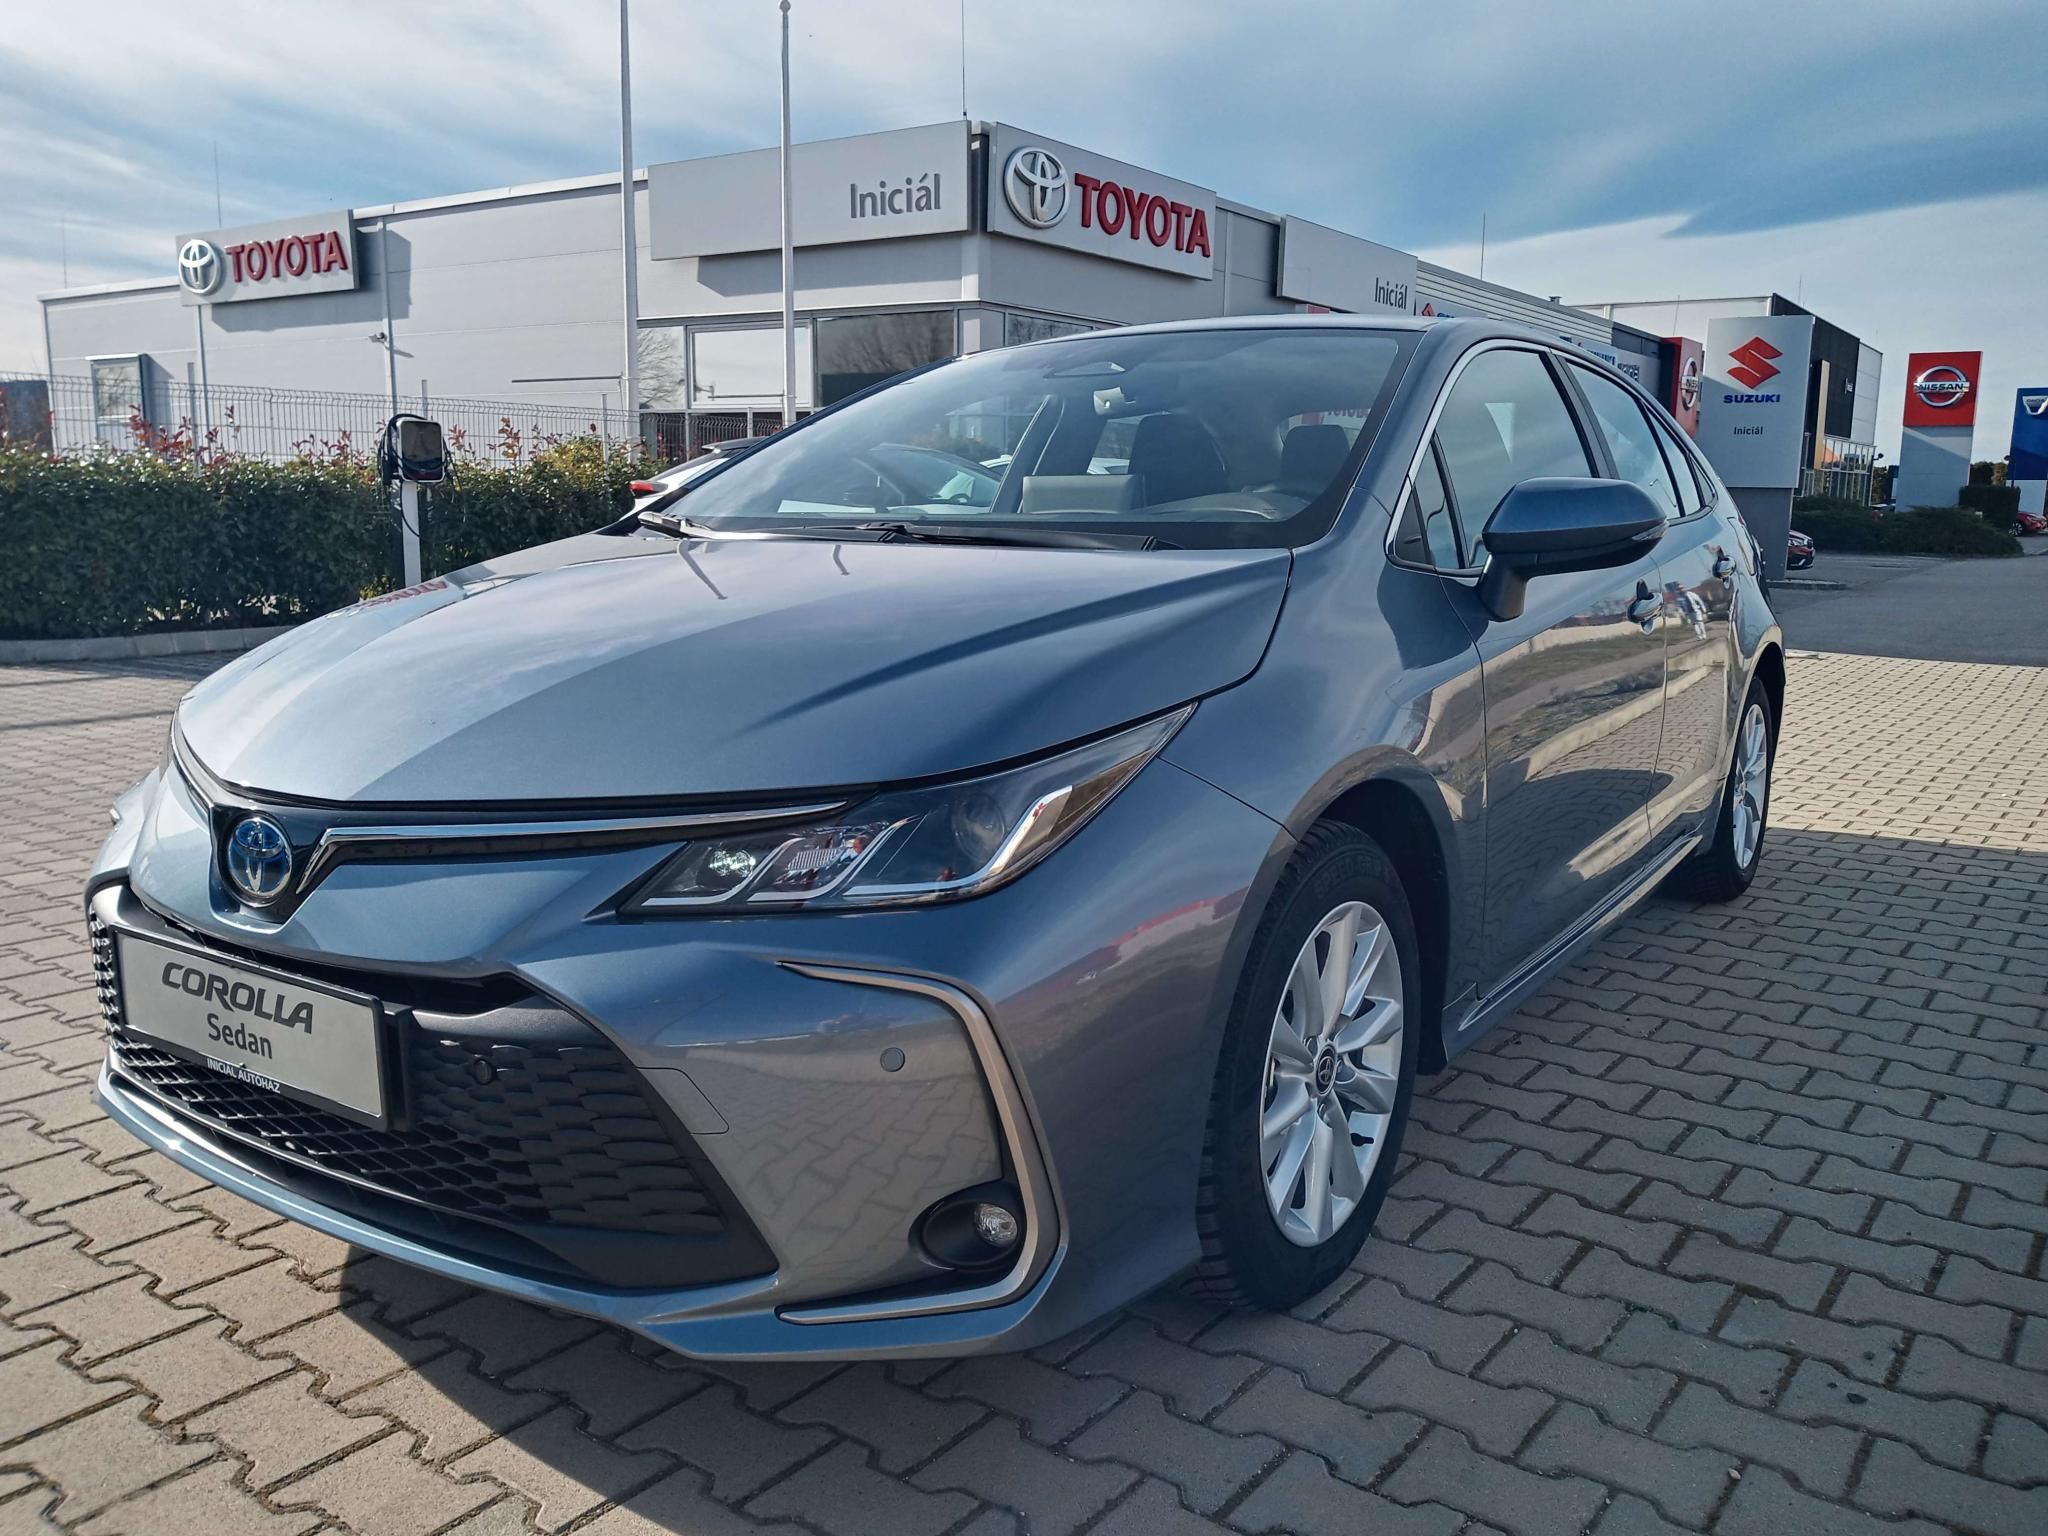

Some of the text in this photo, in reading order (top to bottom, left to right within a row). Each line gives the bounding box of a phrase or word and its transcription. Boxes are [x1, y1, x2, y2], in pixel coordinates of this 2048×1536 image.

[850, 173, 941, 218] Iniciál
[1074, 172, 1211, 258] TOYOTA
[224, 231, 348, 283] TOYOTA
[1375, 276, 1407, 310] Iniciál
[1723, 394, 1781, 403] SUZUKI
[1918, 383, 1964, 391] NISSAN
[1733, 426, 1763, 435] Iniciál
[162, 961, 313, 1034] COROLLA
[206, 1013, 273, 1060] Sedan
